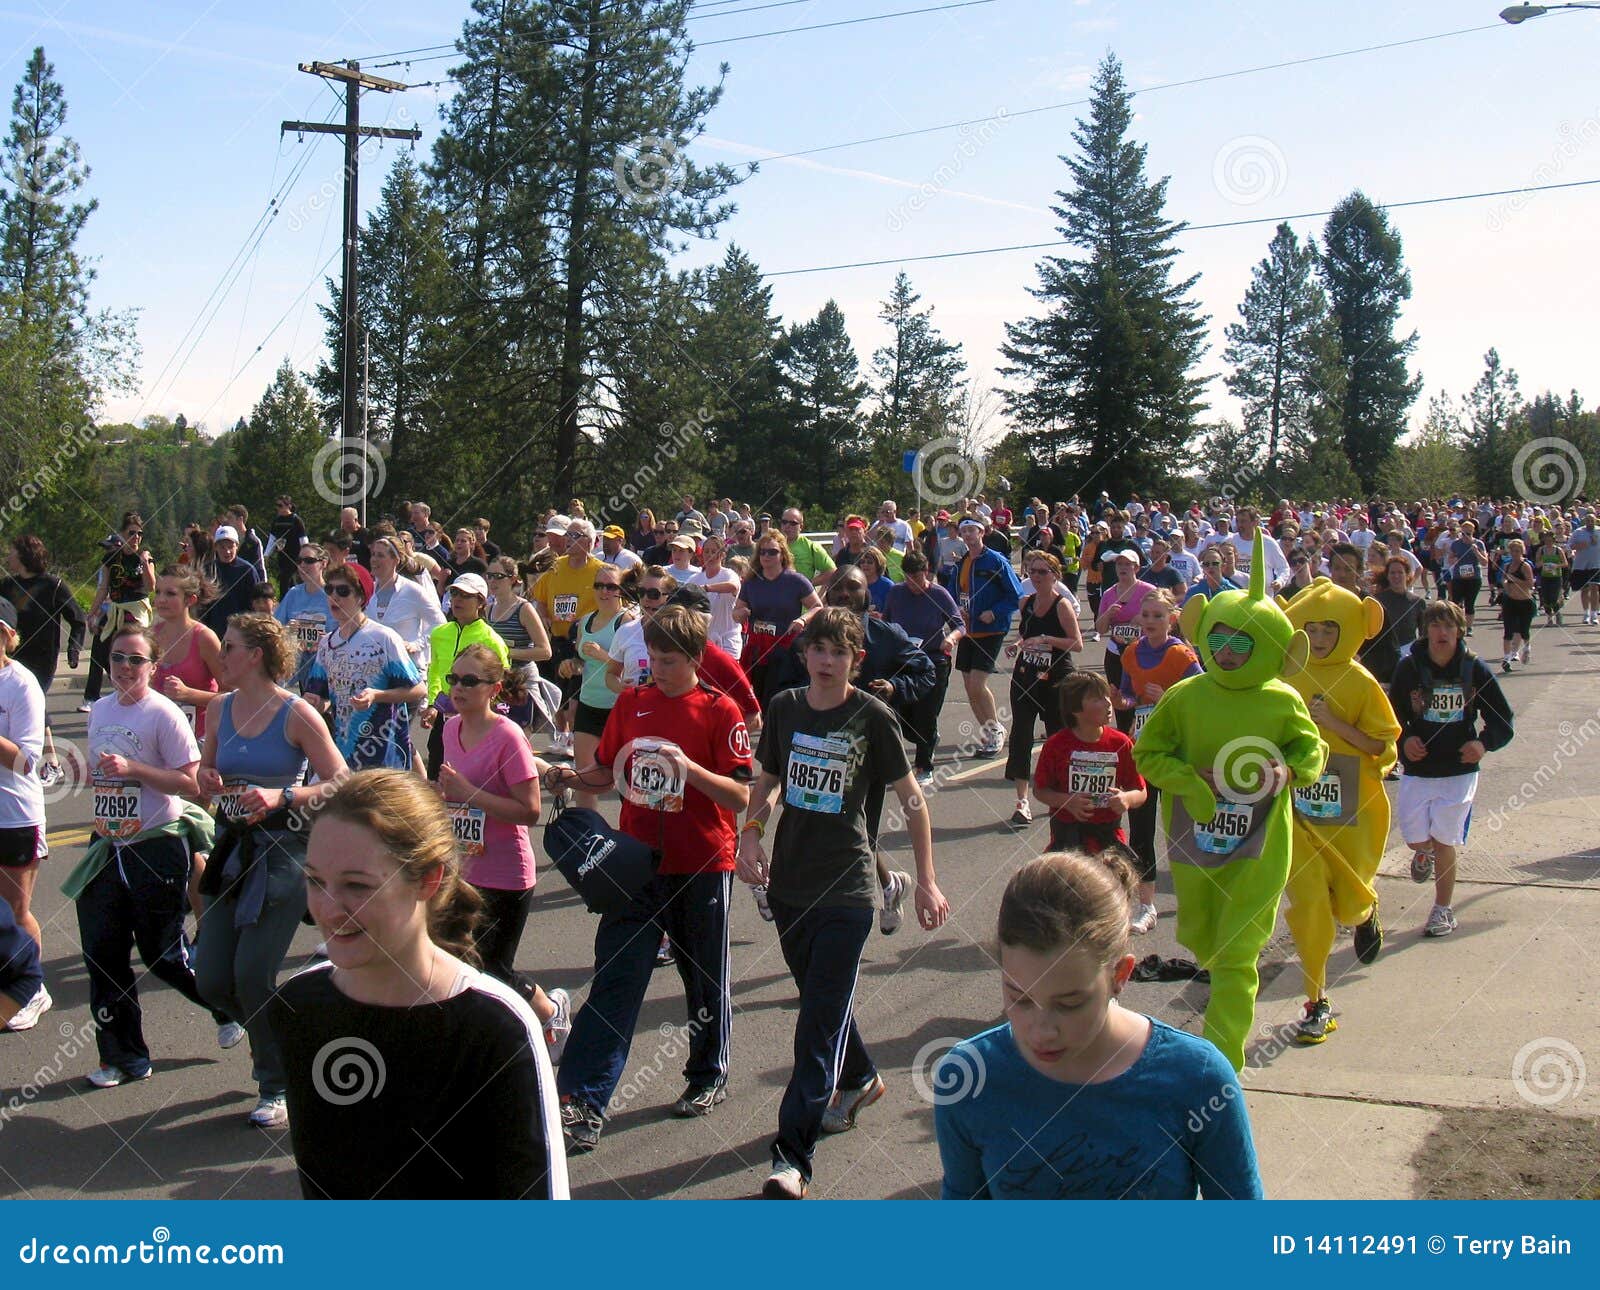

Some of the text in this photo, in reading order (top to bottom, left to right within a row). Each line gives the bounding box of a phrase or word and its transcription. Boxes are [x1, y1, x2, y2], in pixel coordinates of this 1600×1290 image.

[1429, 694, 1463, 710] 8314
[735, 729, 751, 751] 90
[789, 762, 842, 793] 48576
[1072, 774, 1114, 793] 67897
[95, 795, 138, 818] 22692
[452, 817, 481, 841] 826
